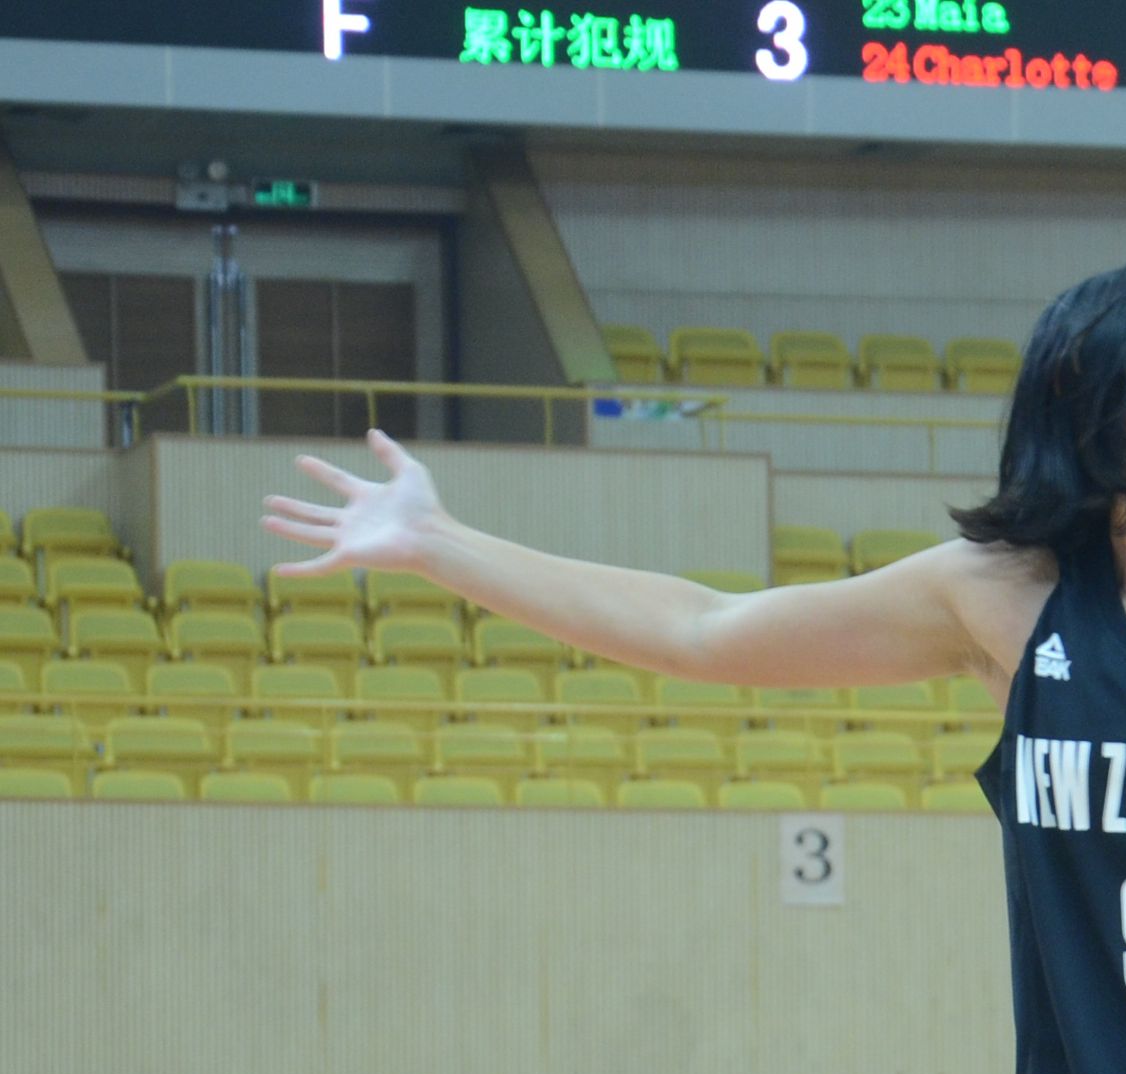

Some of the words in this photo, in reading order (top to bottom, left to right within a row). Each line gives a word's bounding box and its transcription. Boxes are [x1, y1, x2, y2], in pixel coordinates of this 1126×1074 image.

[459, 7, 679, 71] 累计犯规
[755, 0, 808, 81] 3
[862, 41, 911, 84] 24
[913, 45, 1118, 91] Charlotte
[1016, 734, 1092, 831] NEW
[793, 827, 832, 886] 3
